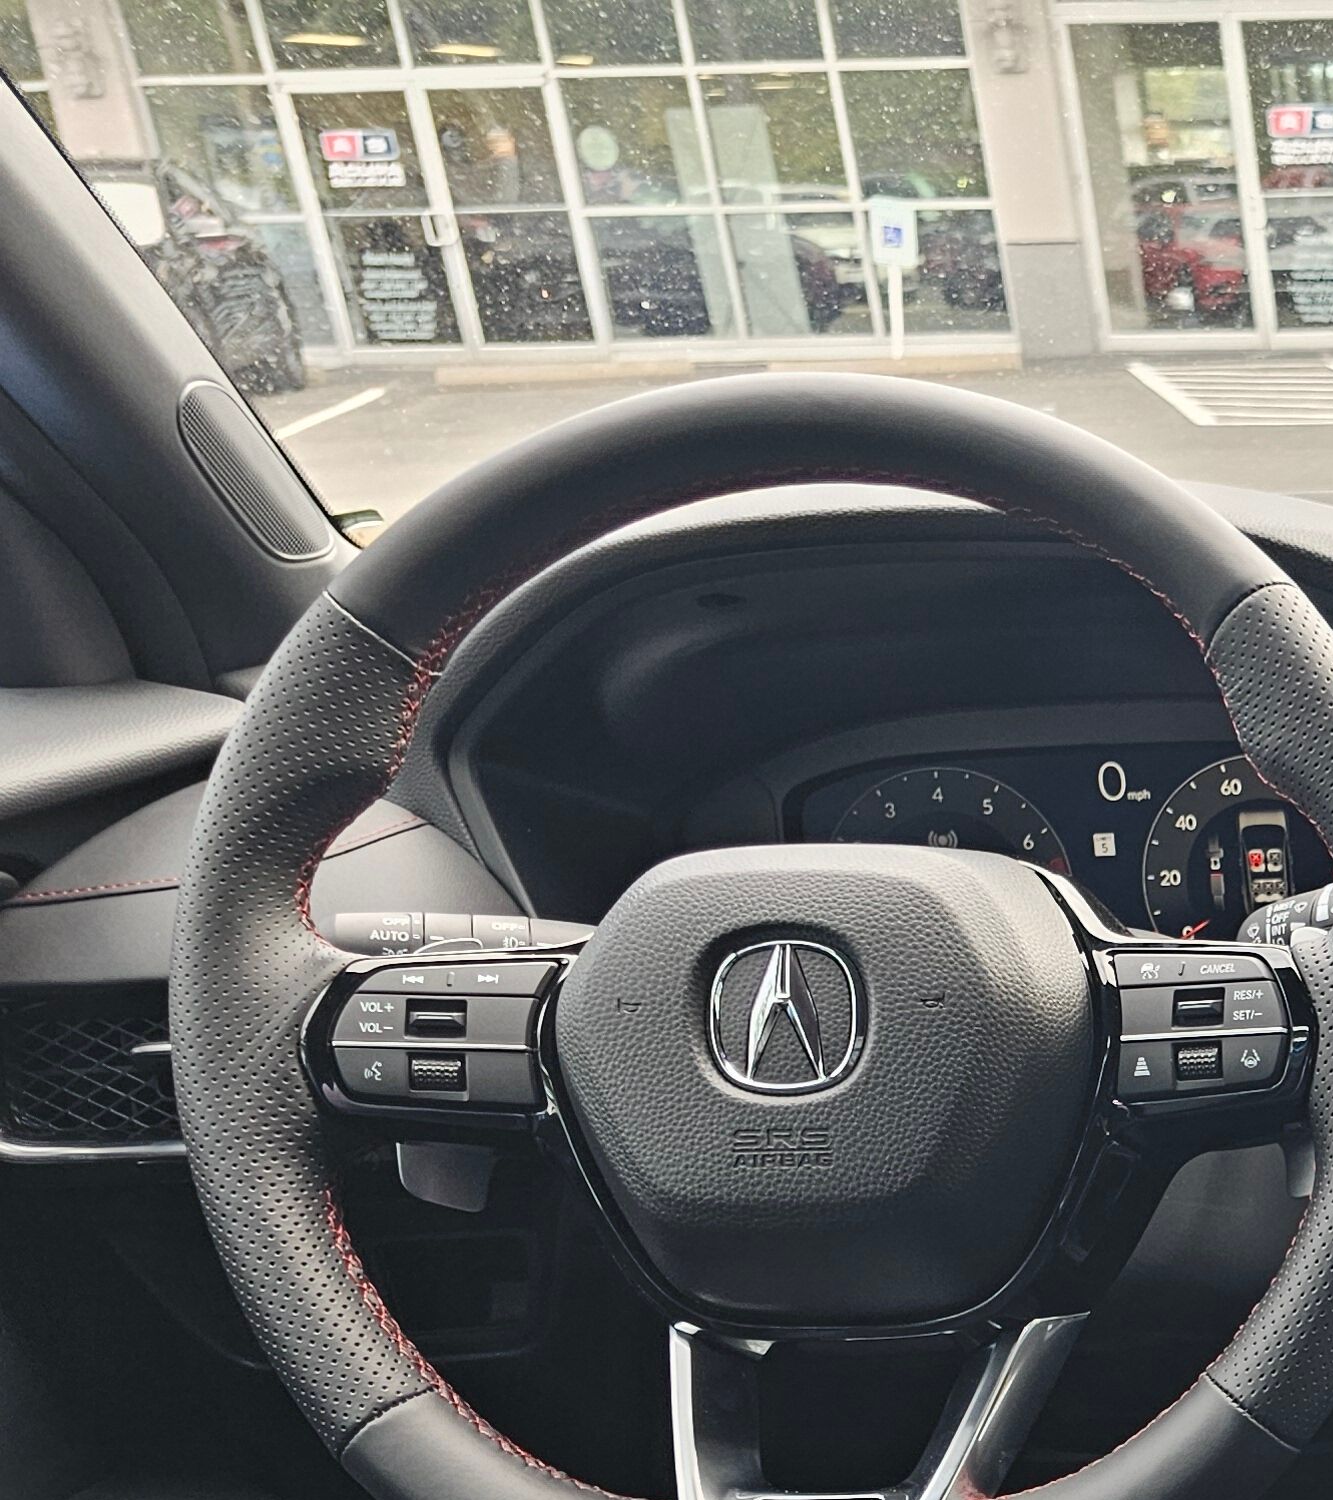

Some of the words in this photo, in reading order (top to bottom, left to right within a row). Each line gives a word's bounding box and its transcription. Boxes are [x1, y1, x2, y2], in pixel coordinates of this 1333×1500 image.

[1097, 760, 1127, 802] 0
[1220, 778, 1243, 796] 60
[931, 787, 943, 803] 4
[1127, 788, 1151, 802] mph
[884, 802, 896, 819] 3
[982, 798, 994, 815] 5
[1175, 813, 1198, 831] 40
[1022, 833, 1035, 850] 6
[1159, 869, 1182, 887] 20
[1271, 912, 1290, 924] OFF
[370, 929, 410, 942] AUTO
[1271, 924, 1287, 936] INT
[1200, 962, 1236, 974] CANCEL
[1233, 990, 1265, 1001] RES/+
[733, 1128, 832, 1149] SRS
[732, 1153, 834, 1169] AIRBAG
